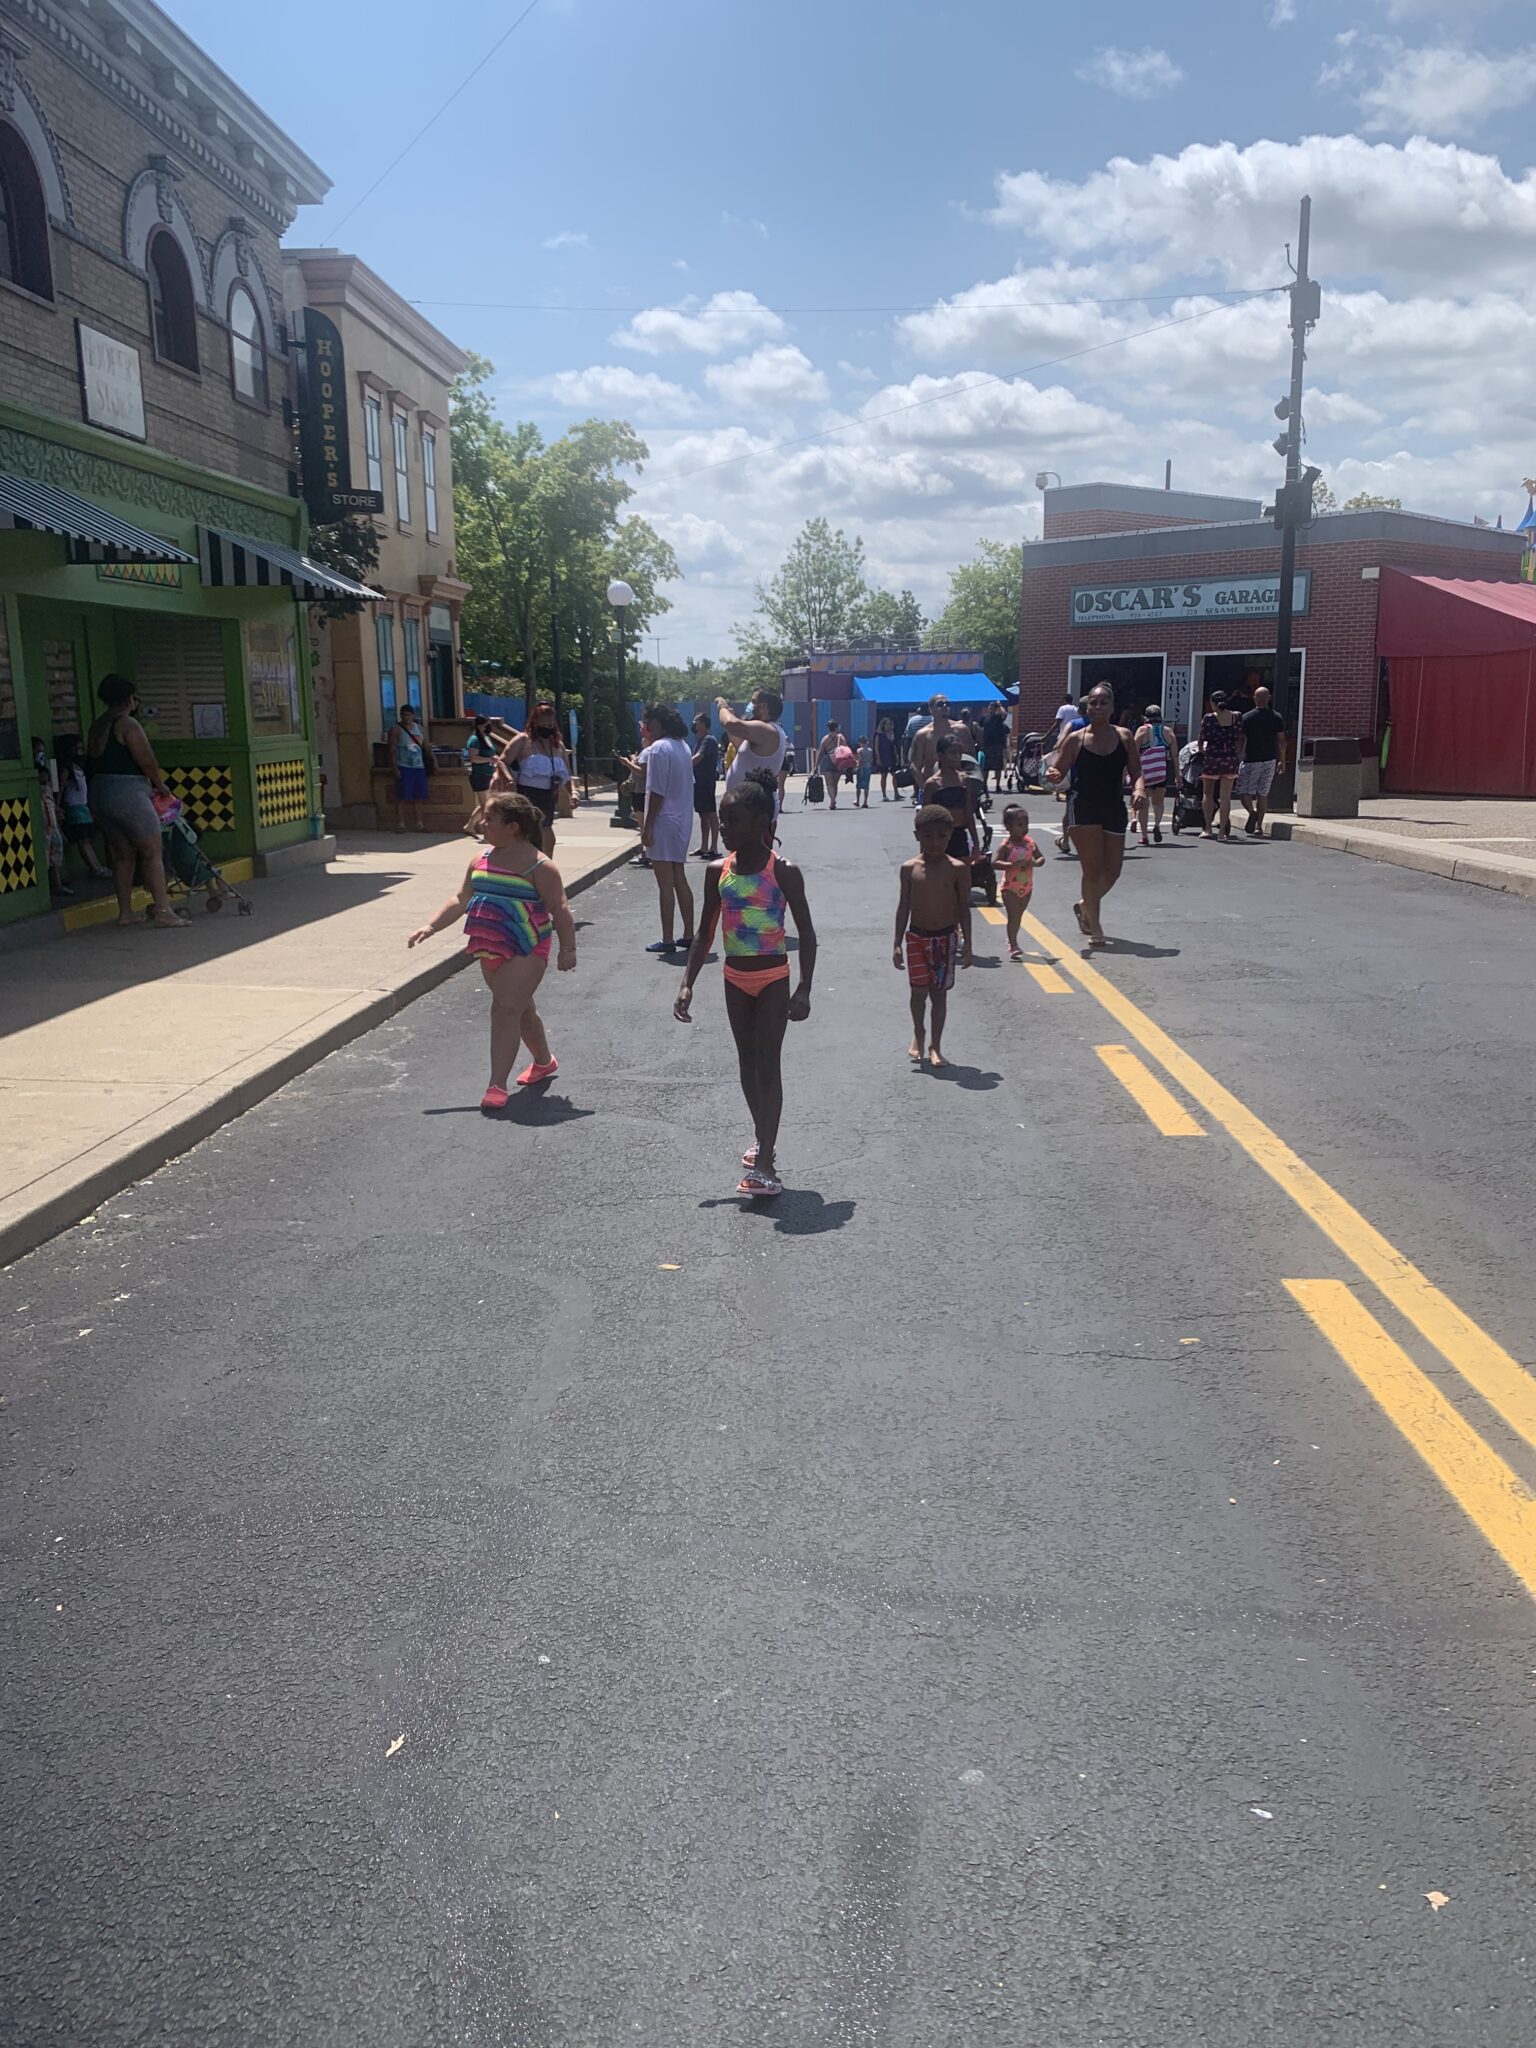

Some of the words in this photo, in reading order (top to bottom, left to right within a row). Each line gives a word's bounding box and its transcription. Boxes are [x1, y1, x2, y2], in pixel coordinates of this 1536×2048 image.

[316, 339, 339, 488] HOOPER'S
[332, 494, 376, 507] STORE
[1075, 585, 1202, 613] OSCAR'S
[1205, 606, 1240, 614] SESAME
